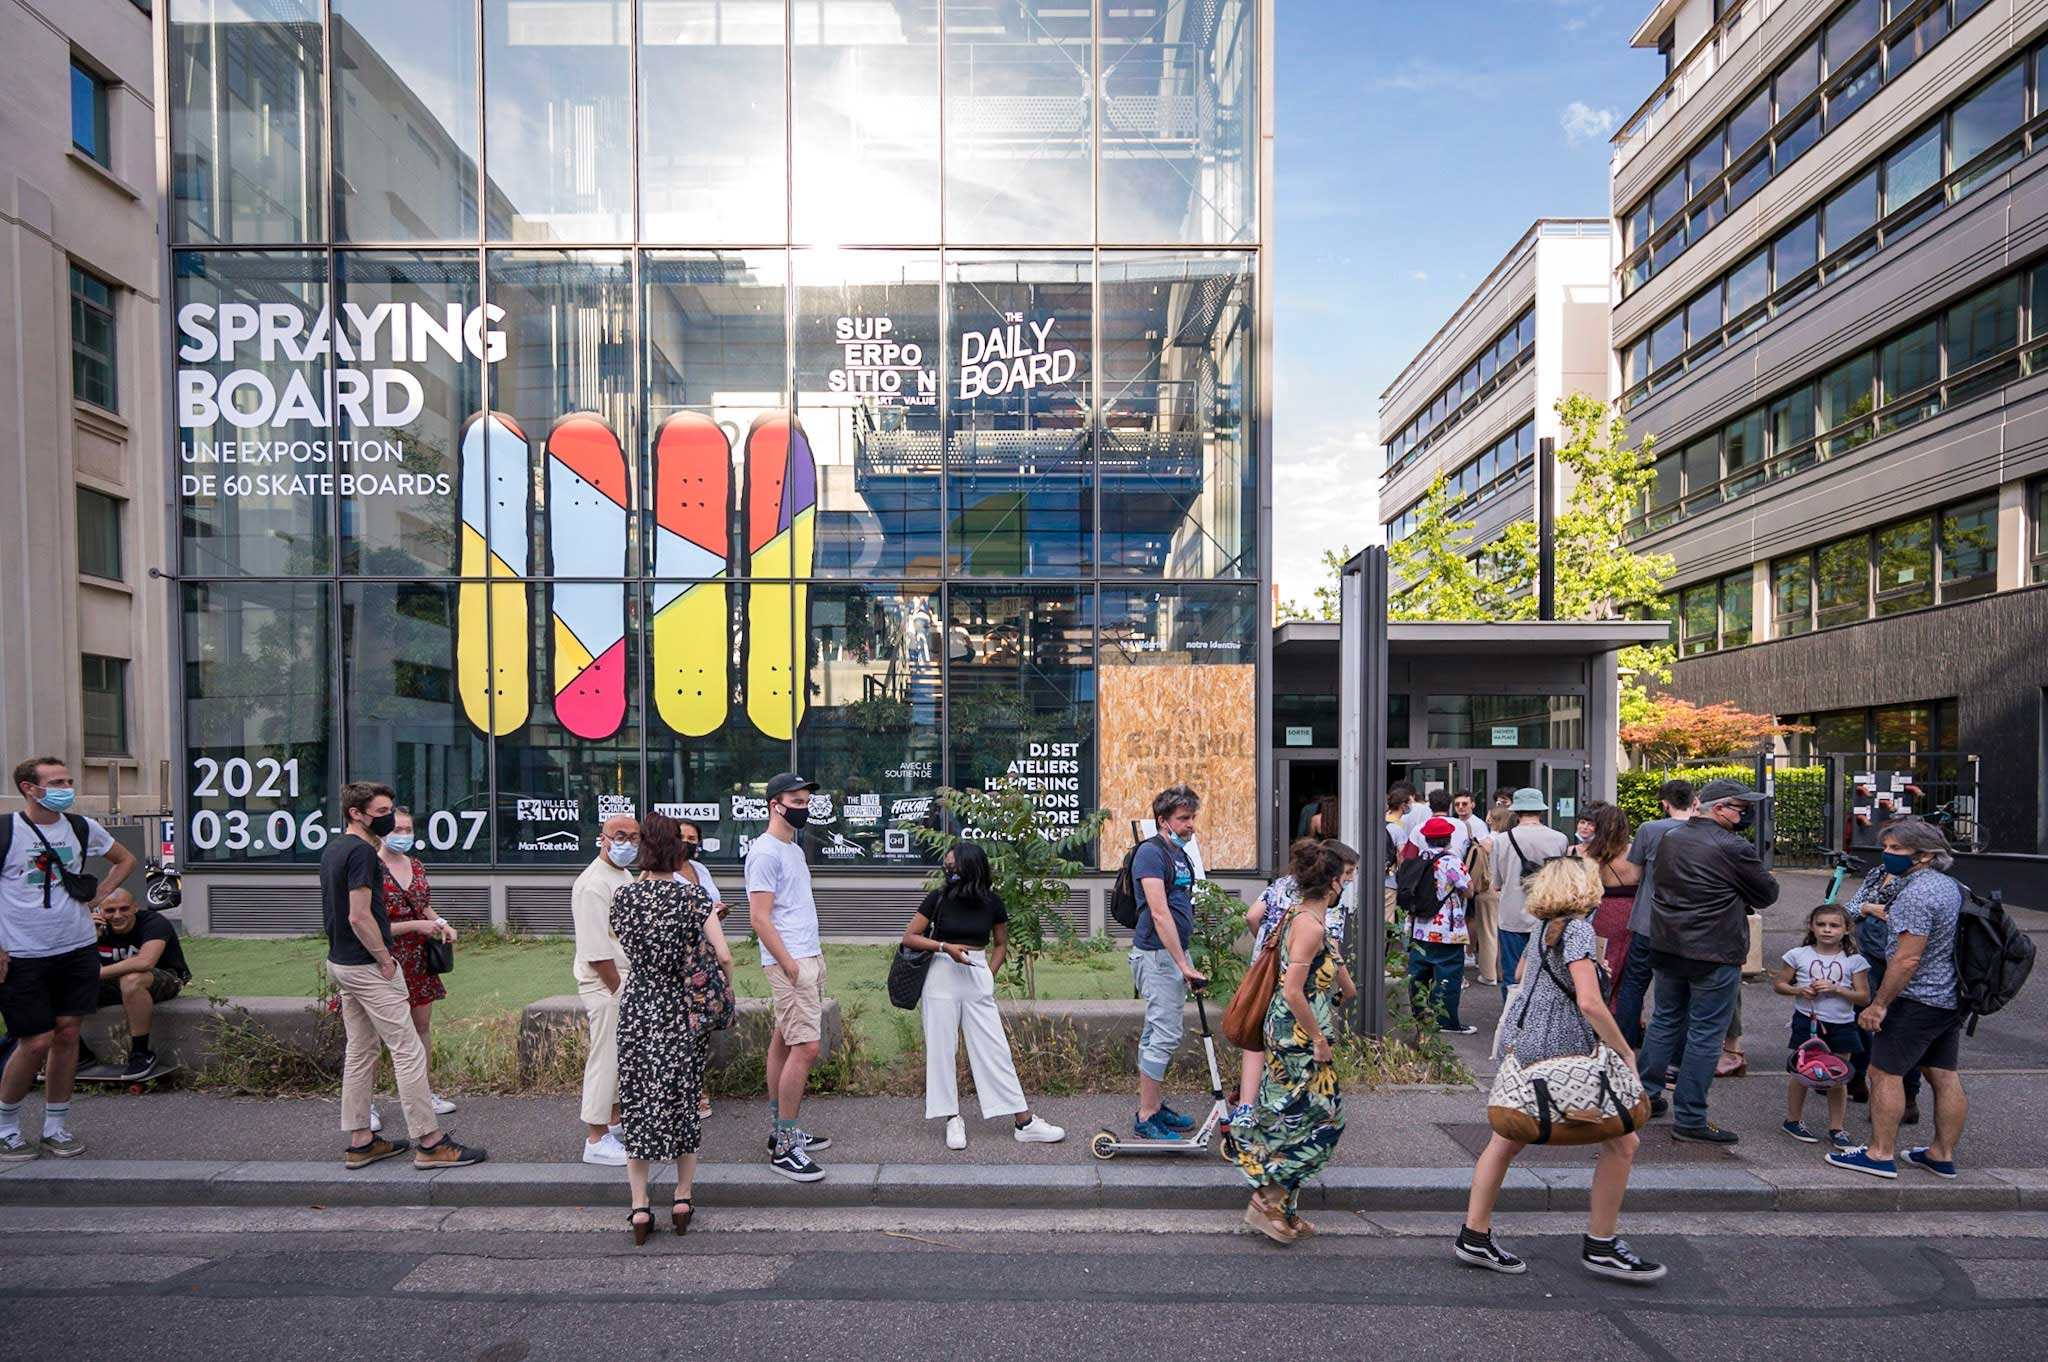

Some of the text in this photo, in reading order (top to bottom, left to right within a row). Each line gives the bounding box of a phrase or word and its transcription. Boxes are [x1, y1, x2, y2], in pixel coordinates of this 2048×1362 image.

[1005, 312, 1024, 323] THE
[178, 302, 507, 363] SPRAYING
[836, 317, 893, 340] SUP
[962, 318, 1055, 366] DAILY
[845, 343, 922, 366] ERPO
[960, 349, 1077, 400] BOARD
[178, 369, 424, 428] BOARD
[904, 397, 936, 405] VALUE
[181, 441, 404, 464] UNE EXPOSITION
[181, 475, 216, 496] DE
[223, 475, 253, 496] 60
[1029, 743, 1079, 757] DJ SET
[884, 770, 932, 778] SOUTIEN DE
[900, 761, 932, 770] AVEC LE
[1006, 760, 1079, 774] ATELIERS
[192, 757, 299, 798] 2021
[541, 799, 579, 808] VILLE DE
[847, 795, 879, 805] THE LIVE
[541, 808, 579, 820] LYON
[659, 807, 716, 817] NINKASI
[191, 809, 488, 851] 03.06-.07
